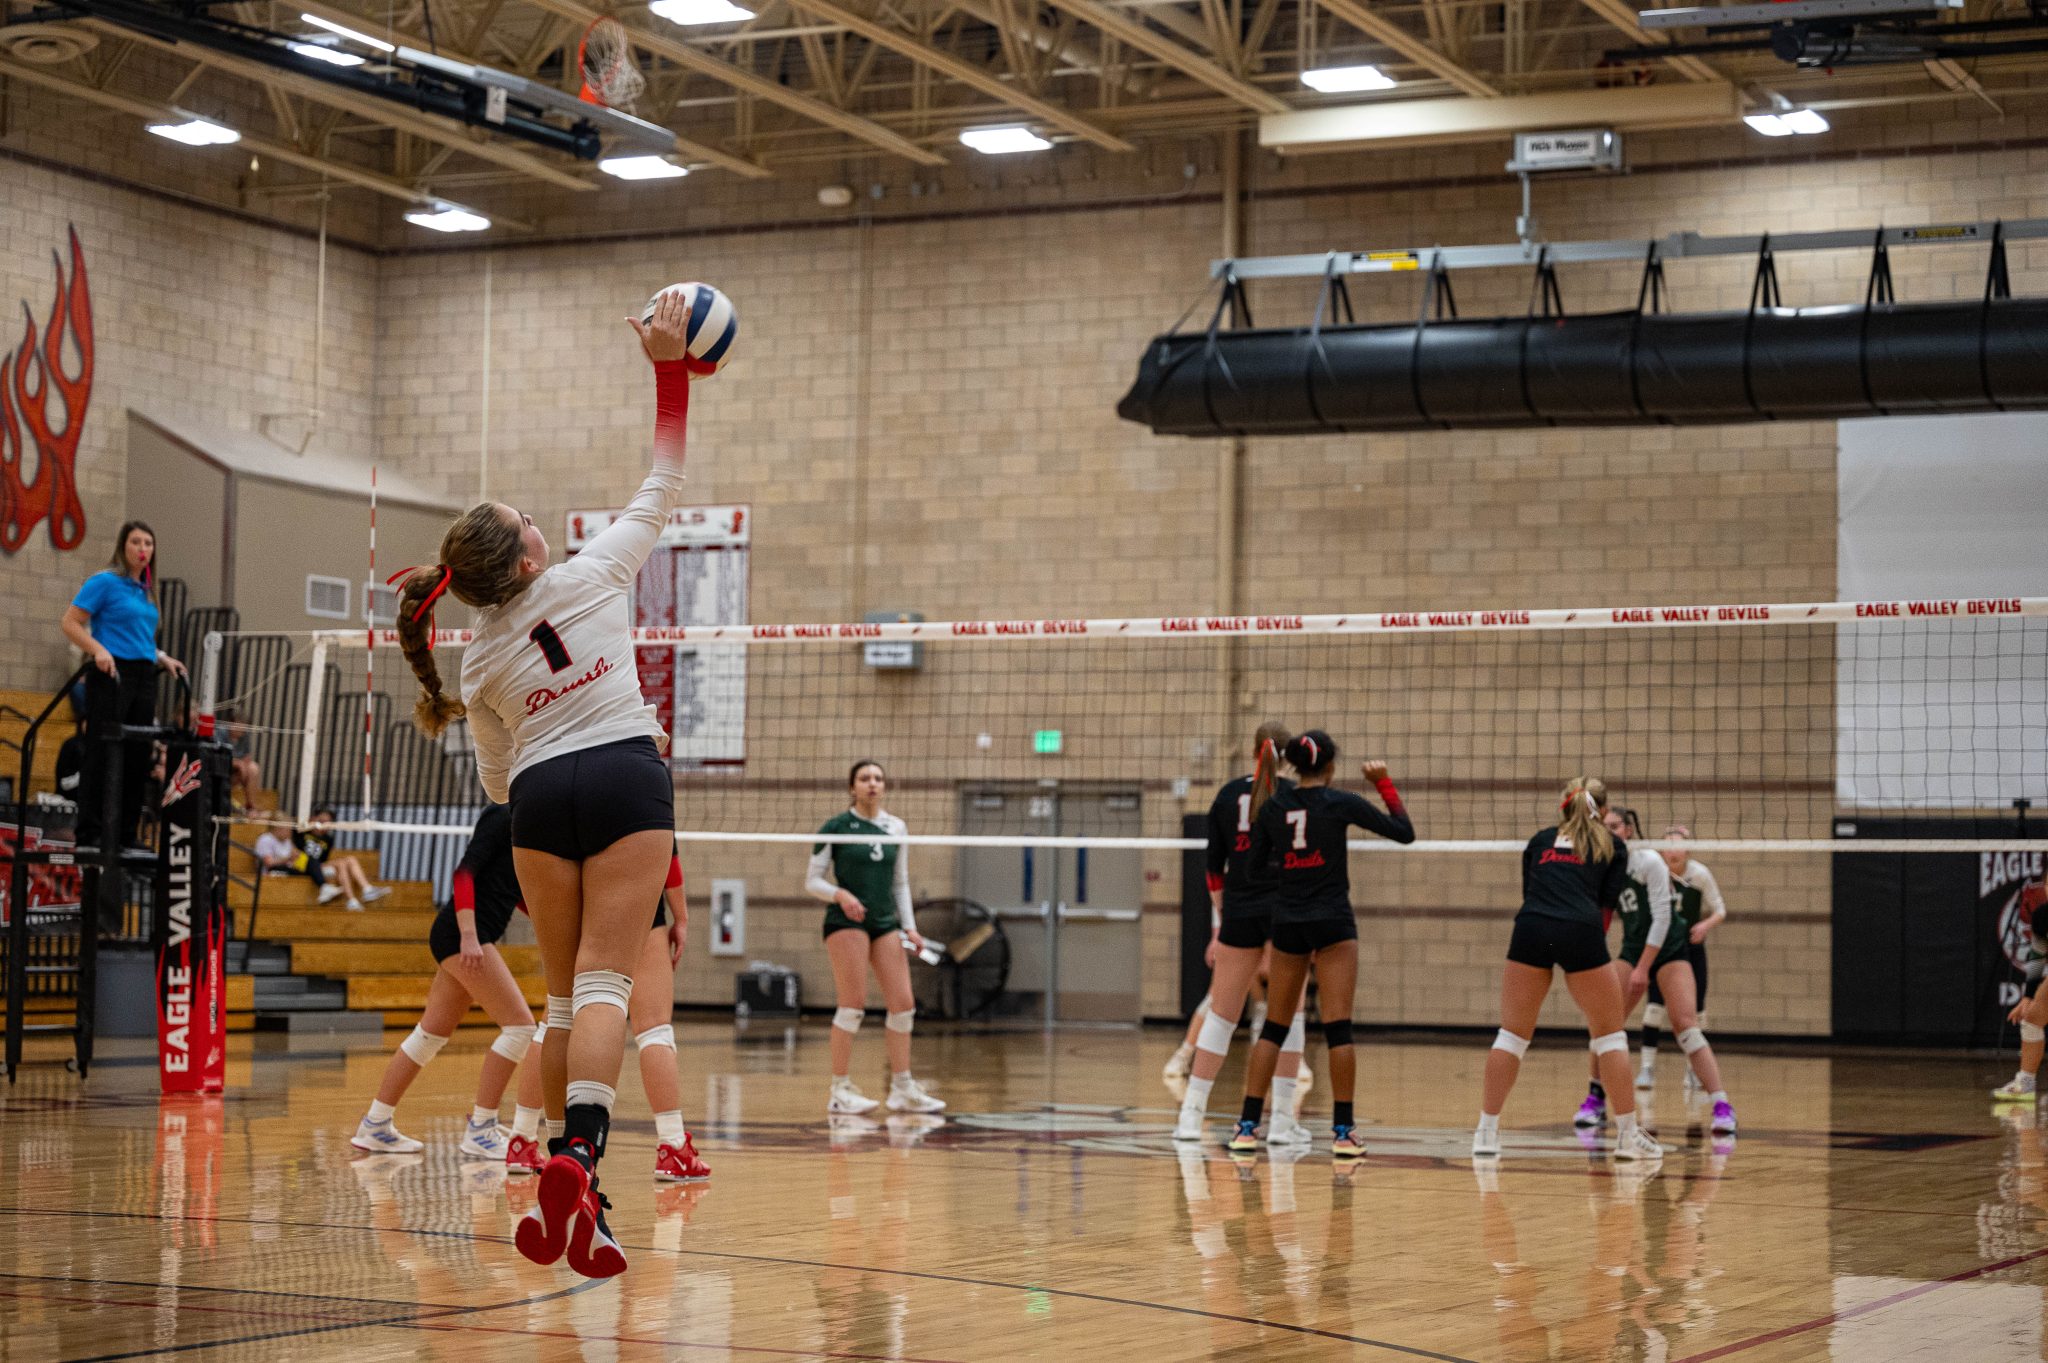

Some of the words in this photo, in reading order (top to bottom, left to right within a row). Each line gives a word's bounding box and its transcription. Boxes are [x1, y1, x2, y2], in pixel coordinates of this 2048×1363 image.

[1612, 610, 1653, 623] EAGLE
[1662, 608, 1709, 622] VALLEY
[1718, 607, 1769, 621] DEVILS
[1856, 603, 1899, 617] EAGLE
[1908, 601, 1958, 616] VALLEY
[1967, 599, 2022, 614] DEVILS
[952, 622, 988, 635] EAGLE
[995, 622, 1035, 634] VALLEY
[1043, 620, 1087, 633] DEVILS
[1161, 619, 1198, 632] EAGLE
[1206, 618, 1249, 631] VALLEY
[1257, 617, 1303, 630] DEVILS
[1381, 614, 1420, 628] EAGLE
[1429, 613, 1473, 626] VALLEY
[1482, 612, 1530, 625] DEVILS
[645, 626, 686, 640] DEVILS
[753, 627, 786, 638] EAGLE
[794, 626, 831, 638] VALLEY
[839, 625, 881, 637] DEVILS
[529, 618, 573, 675] 1
[1285, 809, 1307, 849] 7
[869, 841, 884, 862] 3
[1980, 851, 2043, 898] EAGLE
[168, 823, 192, 947] VALLEY
[1619, 887, 1639, 913] 12
[166, 966, 191, 1073] EAGLE
